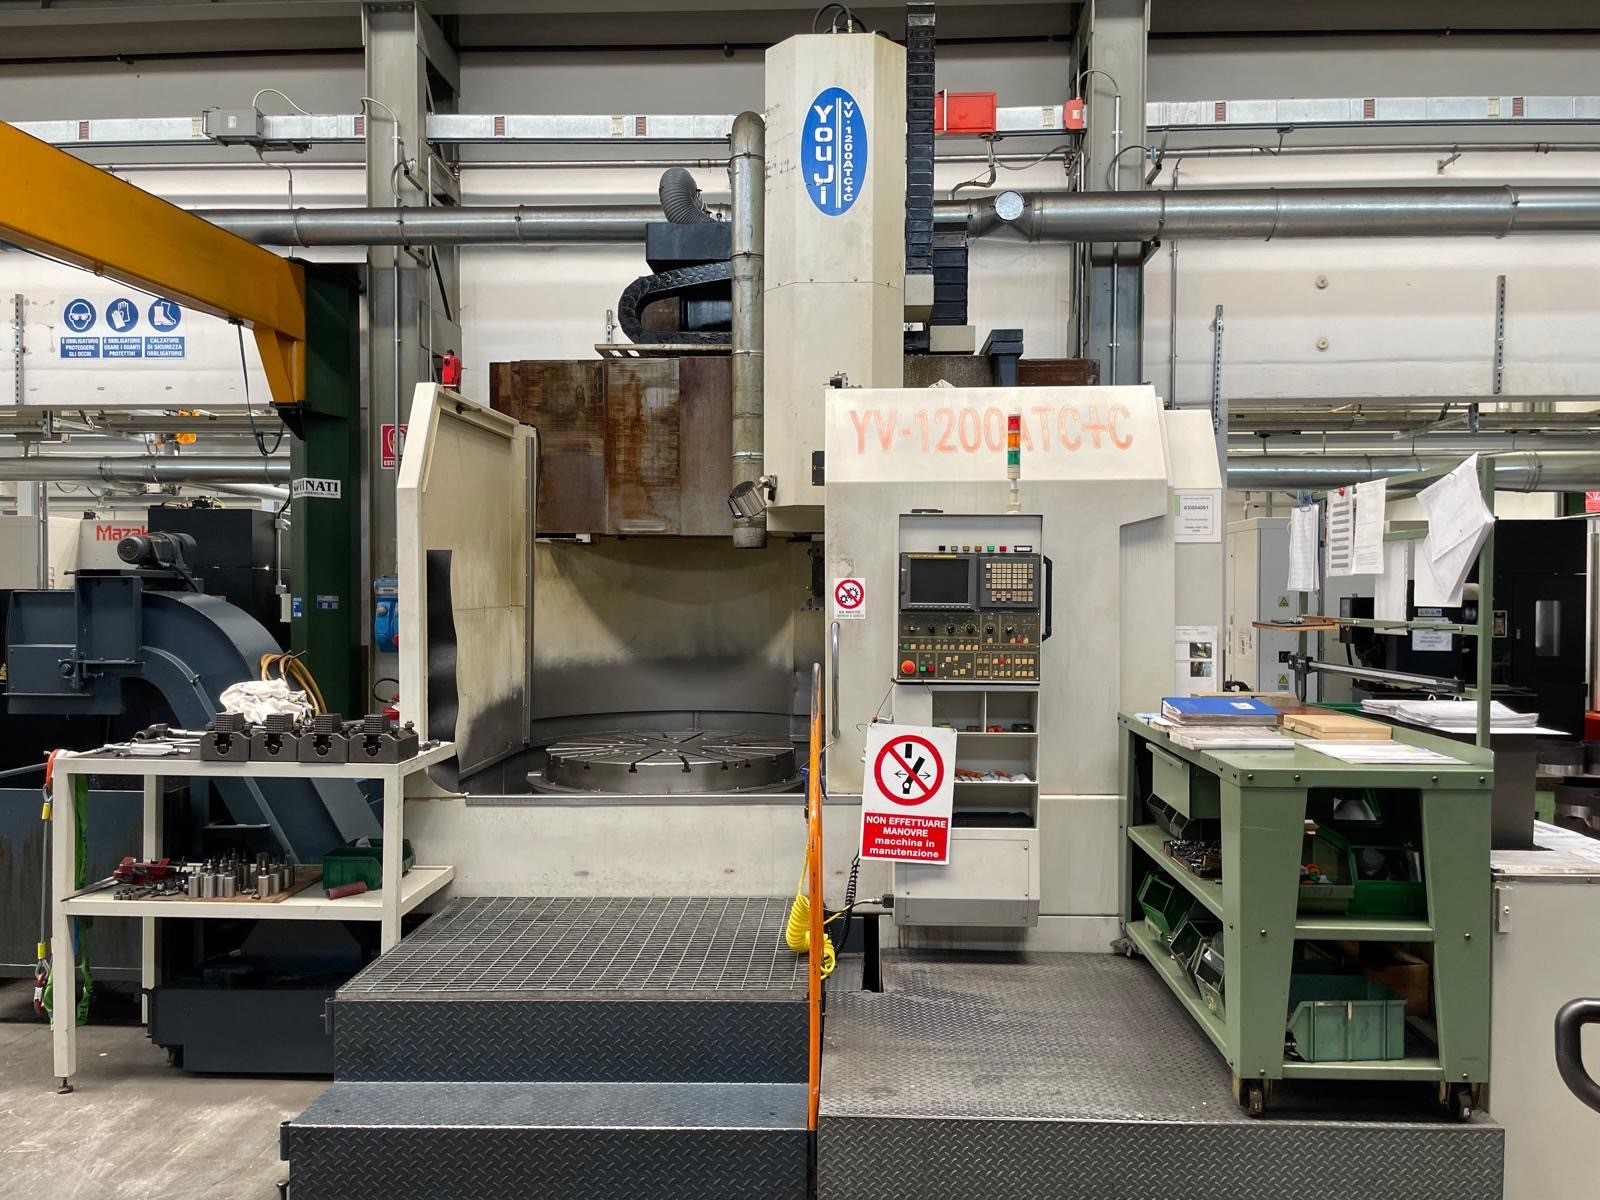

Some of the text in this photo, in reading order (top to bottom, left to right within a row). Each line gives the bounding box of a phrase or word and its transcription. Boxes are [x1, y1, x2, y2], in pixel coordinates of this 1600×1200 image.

[866, 815, 947, 828] NON EFFETTUARE
[883, 826, 929, 837] MANOVRE
[875, 837, 935, 848] macchina in
[869, 847, 939, 858] manutenzione
